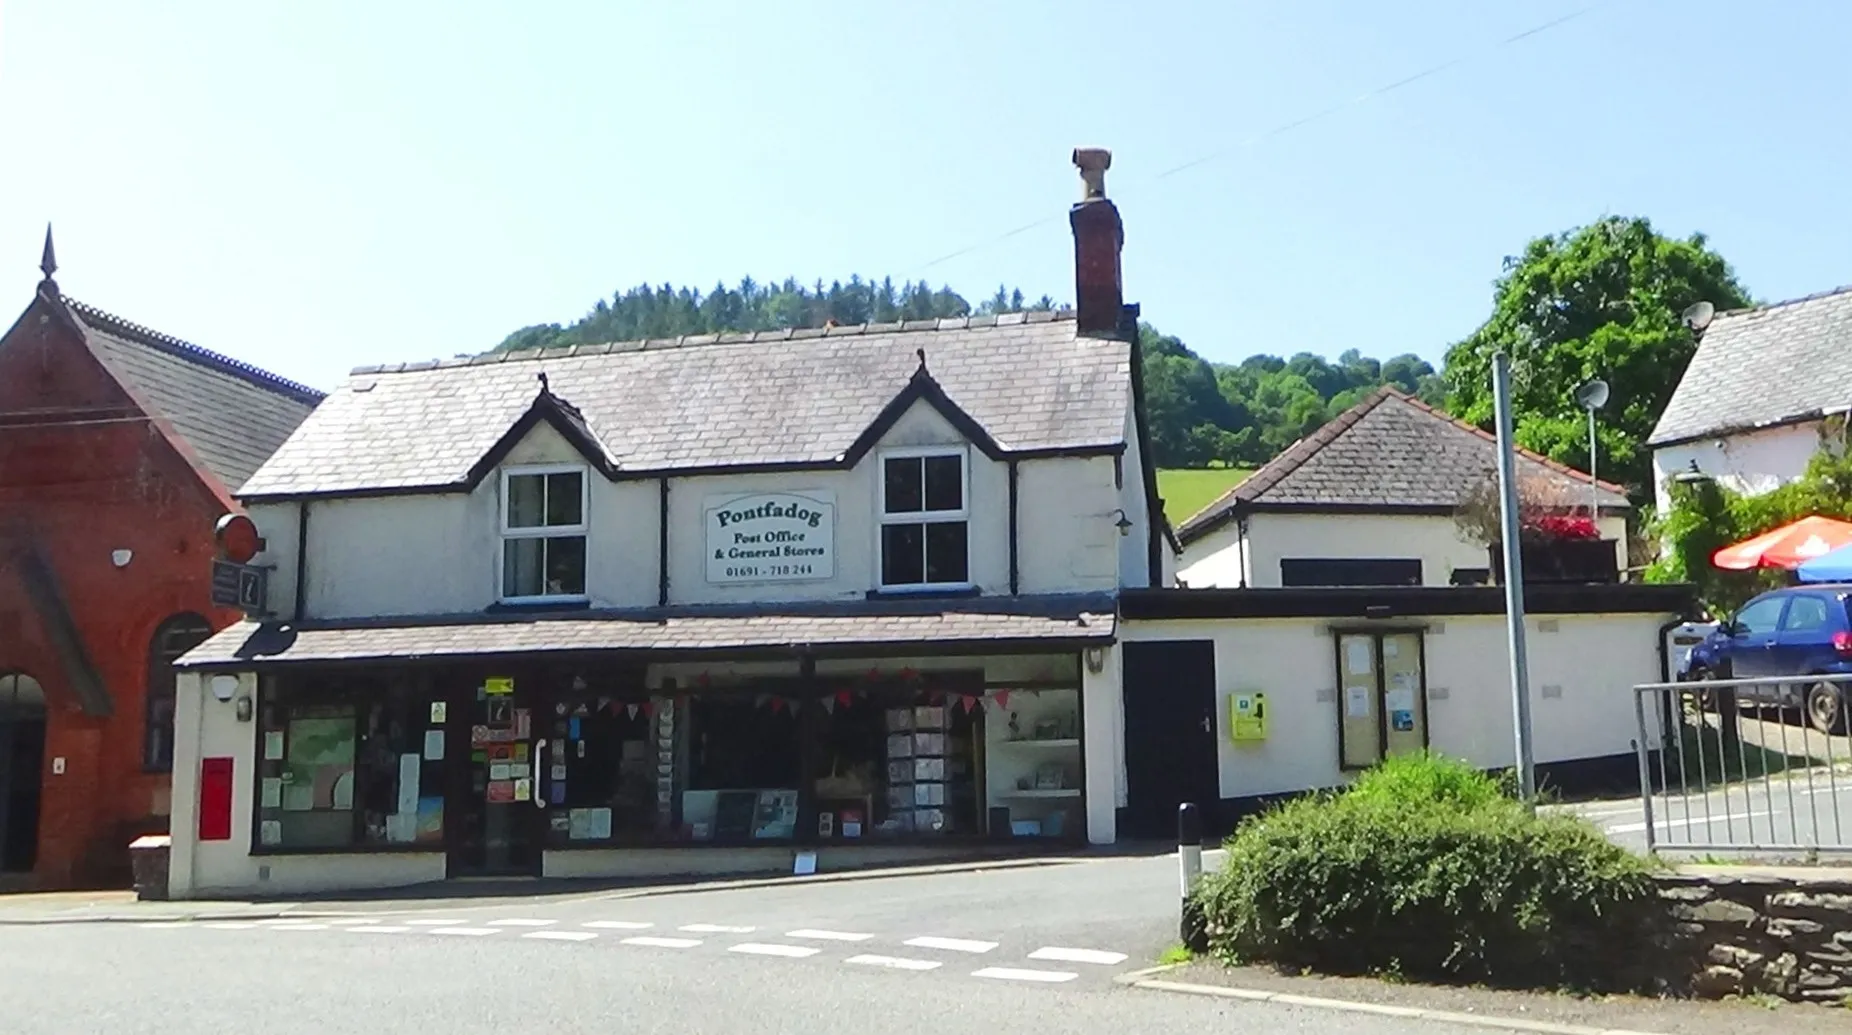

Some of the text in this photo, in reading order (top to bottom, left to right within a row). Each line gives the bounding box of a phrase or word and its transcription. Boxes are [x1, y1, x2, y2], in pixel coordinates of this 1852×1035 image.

[716, 502, 823, 528] Pontfadog
[734, 531, 805, 544] Post Office
[714, 545, 825, 560] & General Stores
[726, 566, 758, 577] 01691
[769, 565, 790, 575] 718
